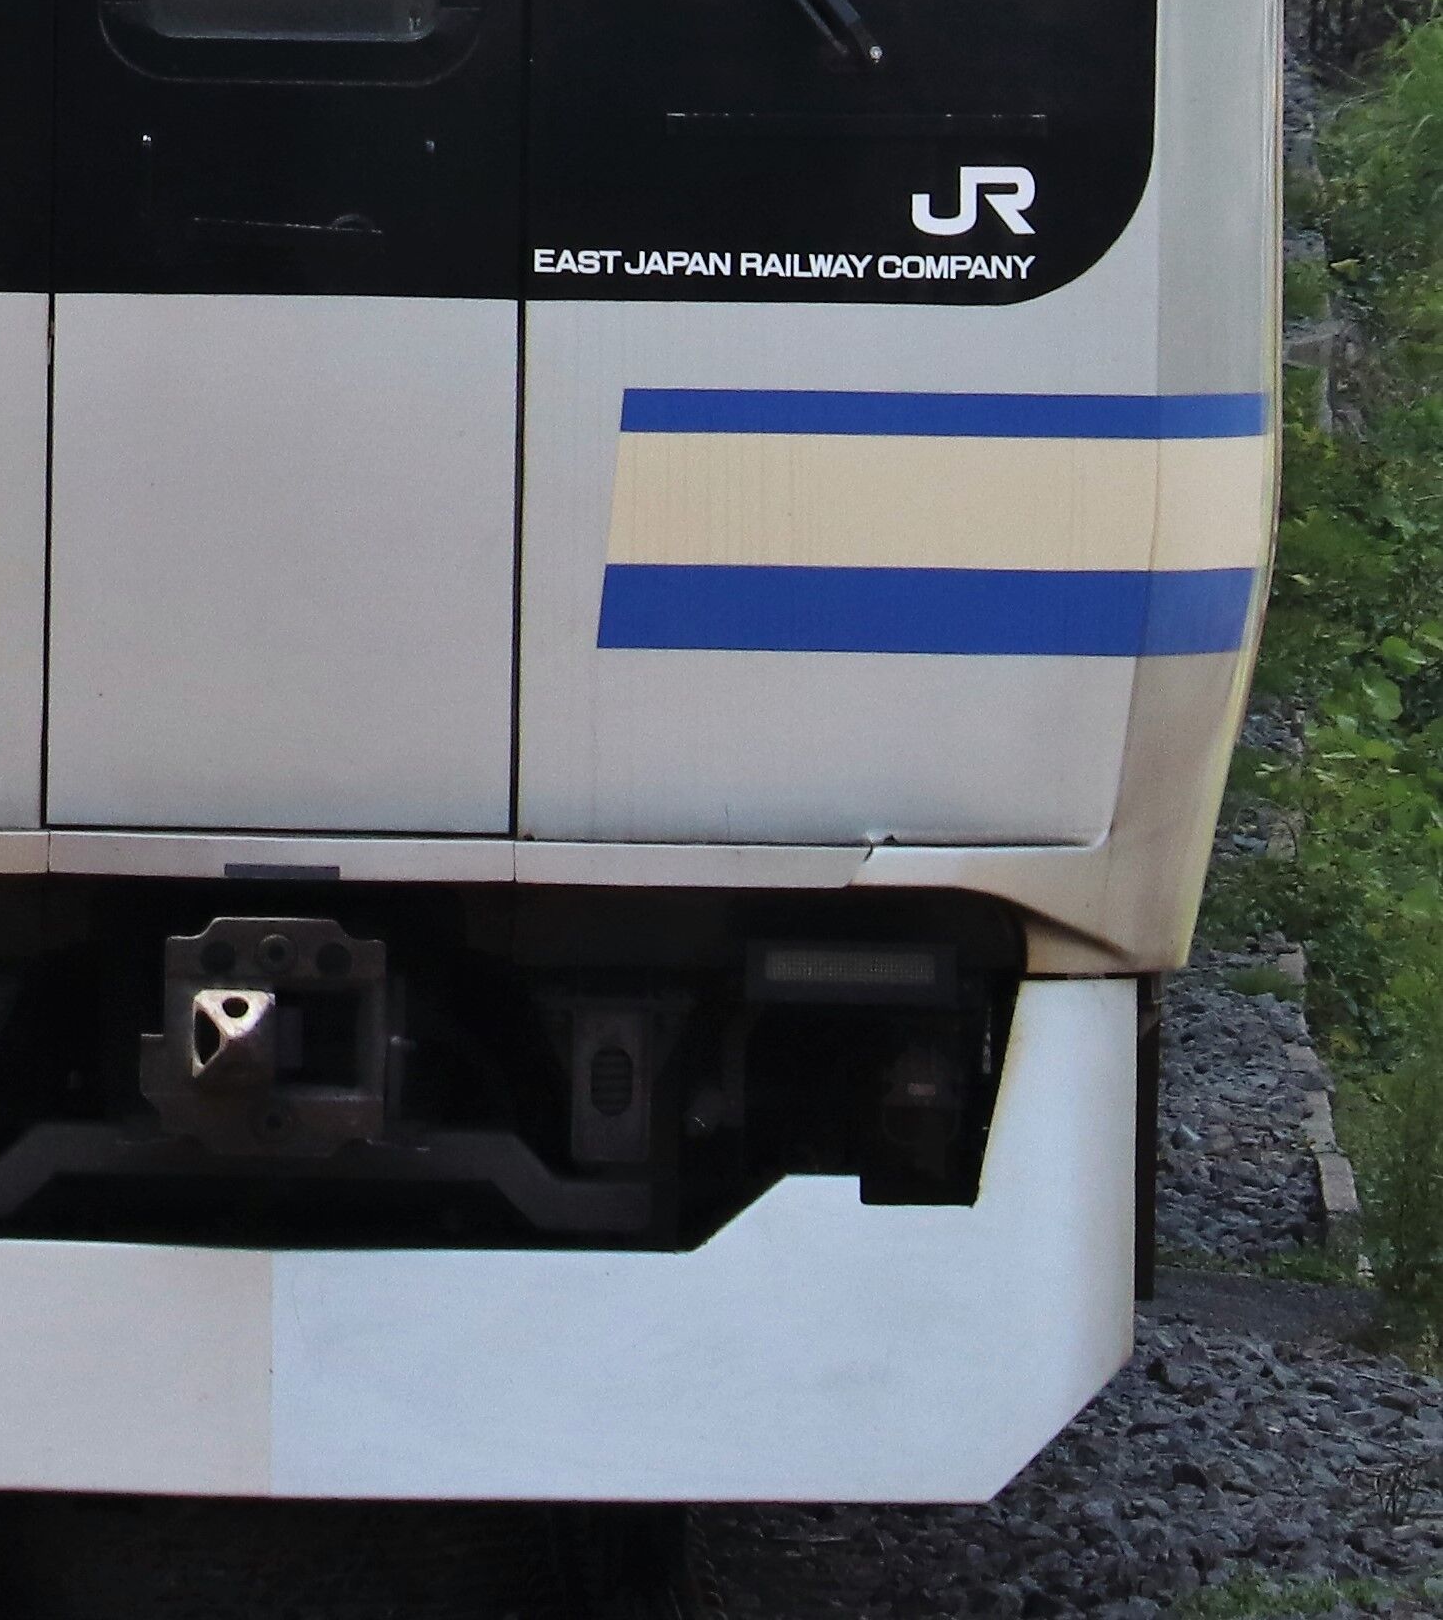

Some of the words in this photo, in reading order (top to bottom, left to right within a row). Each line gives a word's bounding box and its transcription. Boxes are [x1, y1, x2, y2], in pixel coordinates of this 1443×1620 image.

[911, 165, 1036, 236] JR
[533, 248, 621, 275] EAST
[625, 250, 730, 277] JAPAN
[739, 252, 872, 278] RAILWAY
[877, 254, 1036, 280] COMPANY
